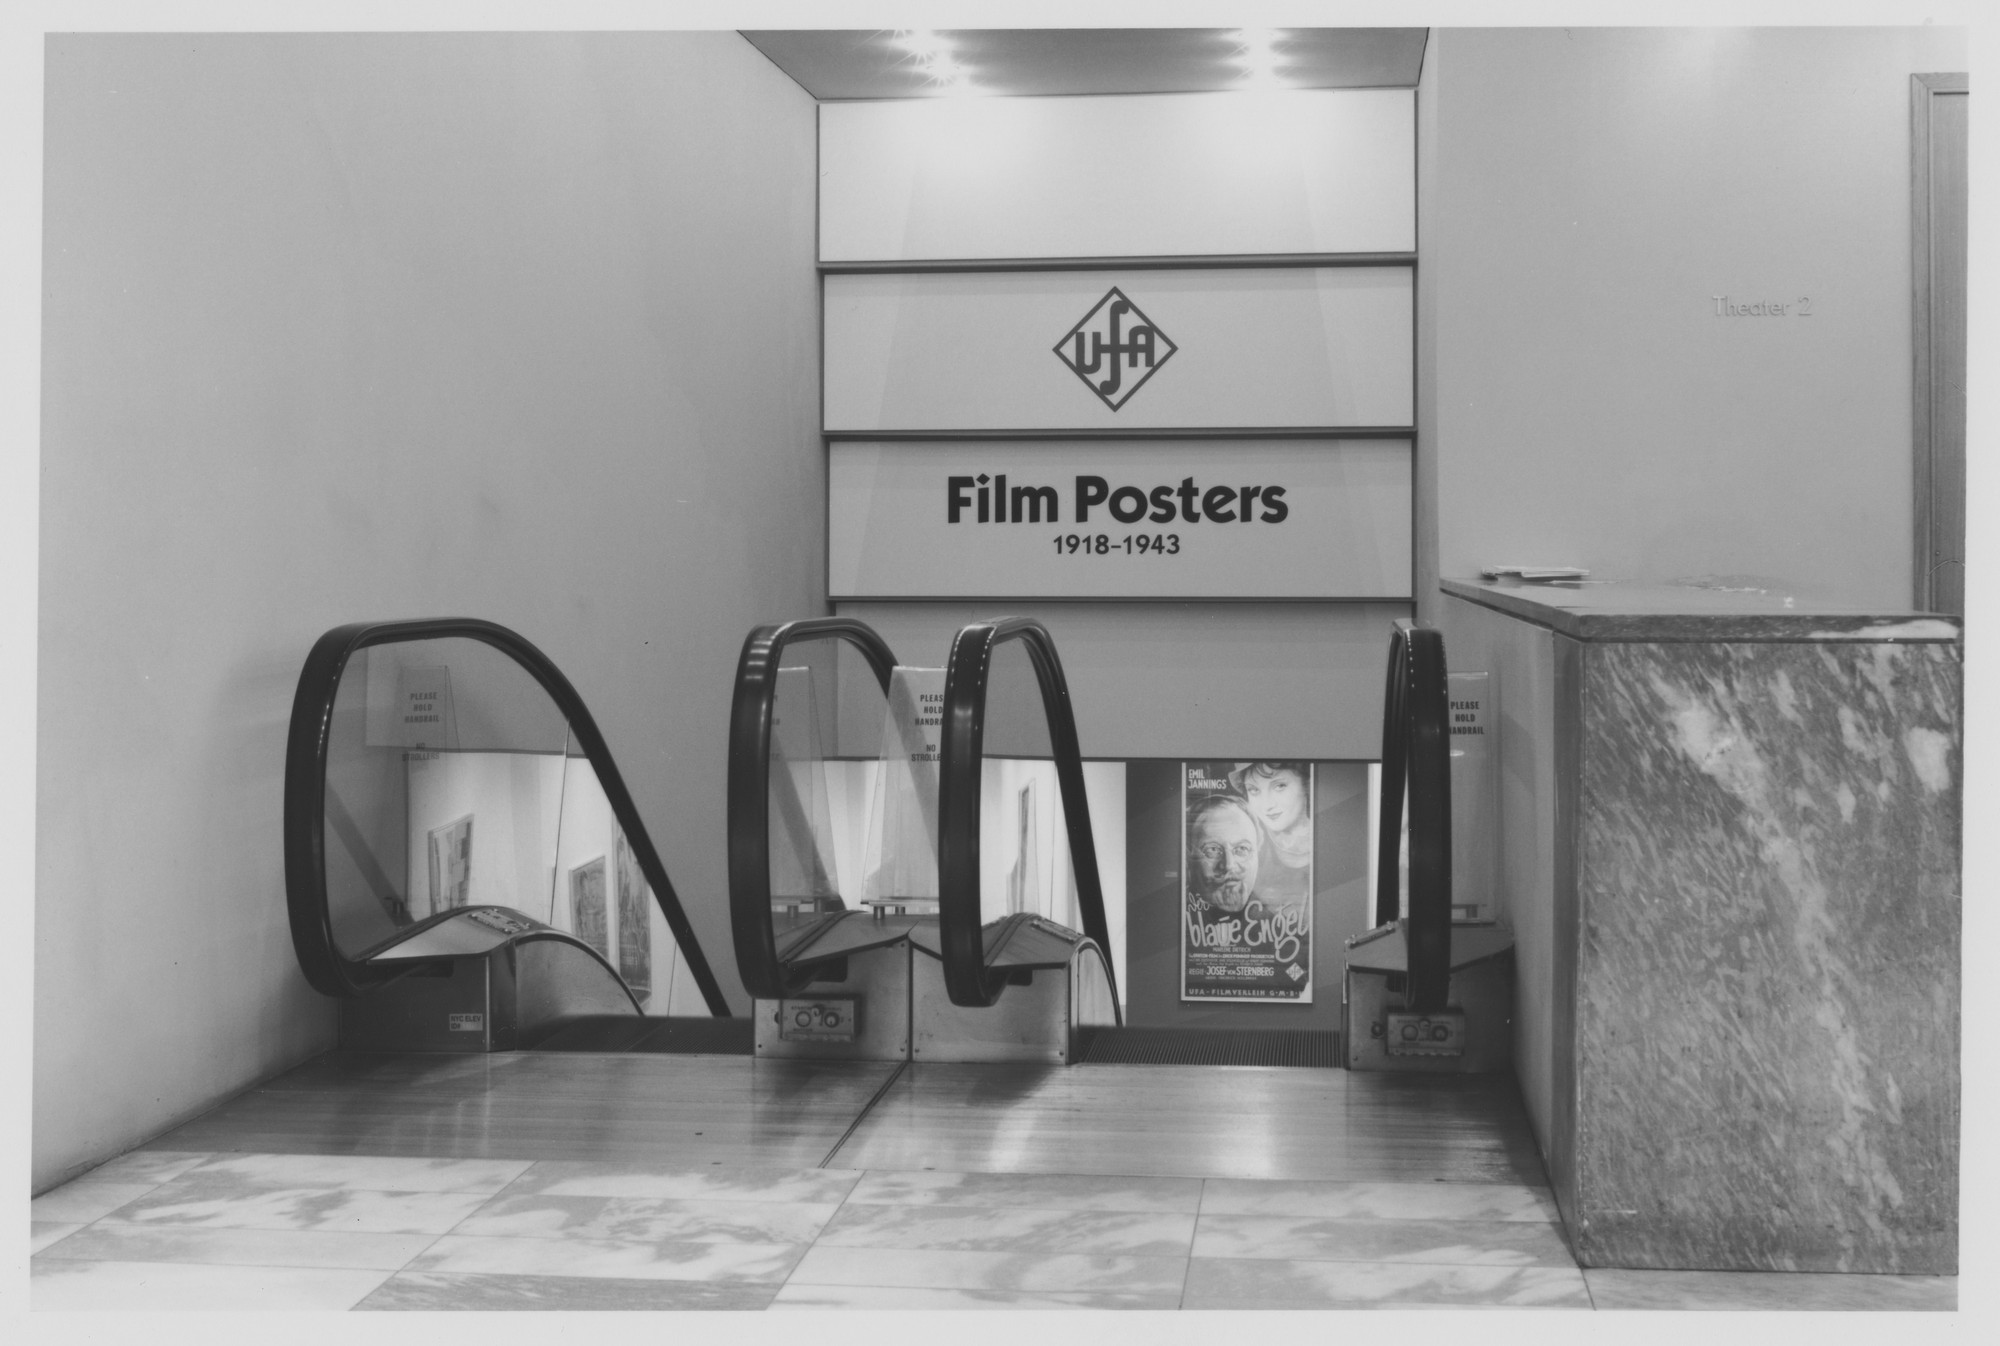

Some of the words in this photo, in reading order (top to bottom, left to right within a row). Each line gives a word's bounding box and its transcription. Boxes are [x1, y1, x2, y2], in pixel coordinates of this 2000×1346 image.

[1712, 295, 1790, 317] Theater
[1797, 296, 1812, 317] 2
[948, 473, 1059, 524] Film
[1075, 475, 1289, 524] Posters
[410, 692, 438, 701] PLEASE
[920, 694, 944, 702] PLEAS
[413, 703, 433, 712] HOLD
[923, 706, 943, 714] HOLD
[1450, 701, 1480, 710] PLEASE
[1455, 713, 1476, 722] HOLD
[926, 744, 937, 752] NO
[911, 753, 941, 762] STROLLE
[1188, 768, 1205, 779] EMIL
[1187, 779, 1227, 790] JANNINGS
[1206, 966, 1227, 976] JOSEF
[1236, 966, 1275, 977] STERNBERG
